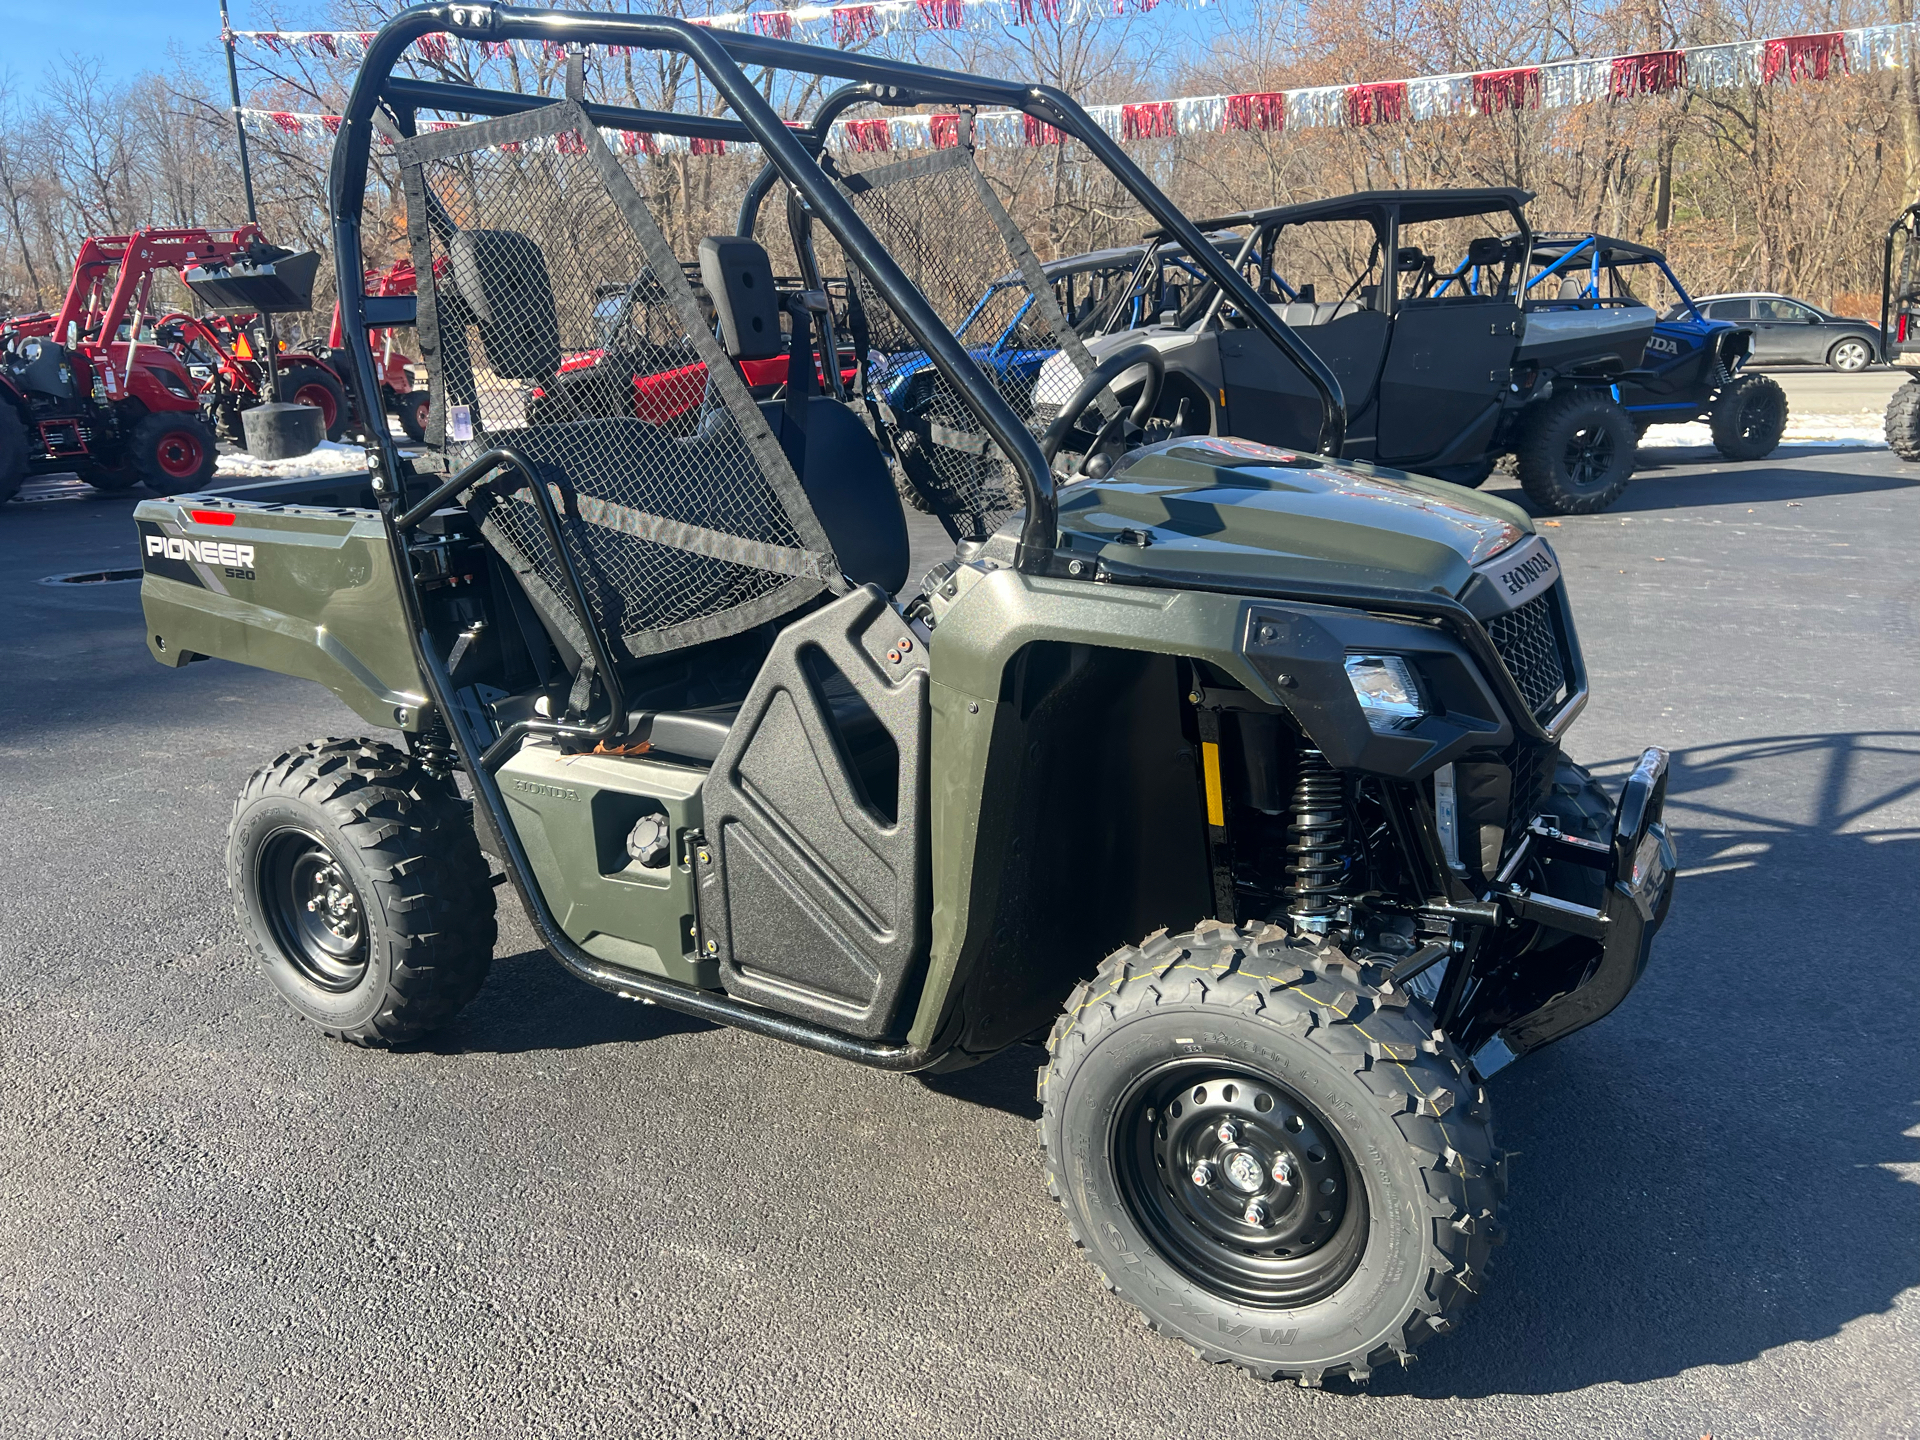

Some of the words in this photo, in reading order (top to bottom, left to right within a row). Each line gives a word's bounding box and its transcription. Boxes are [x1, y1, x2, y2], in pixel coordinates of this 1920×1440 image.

[145, 535, 254, 568] PIONEER
[224, 568, 256, 581] 520
[1499, 552, 1552, 596] HONDA
[513, 778, 581, 802] HONDA
[1100, 1221, 1300, 1346] MAXXIS
